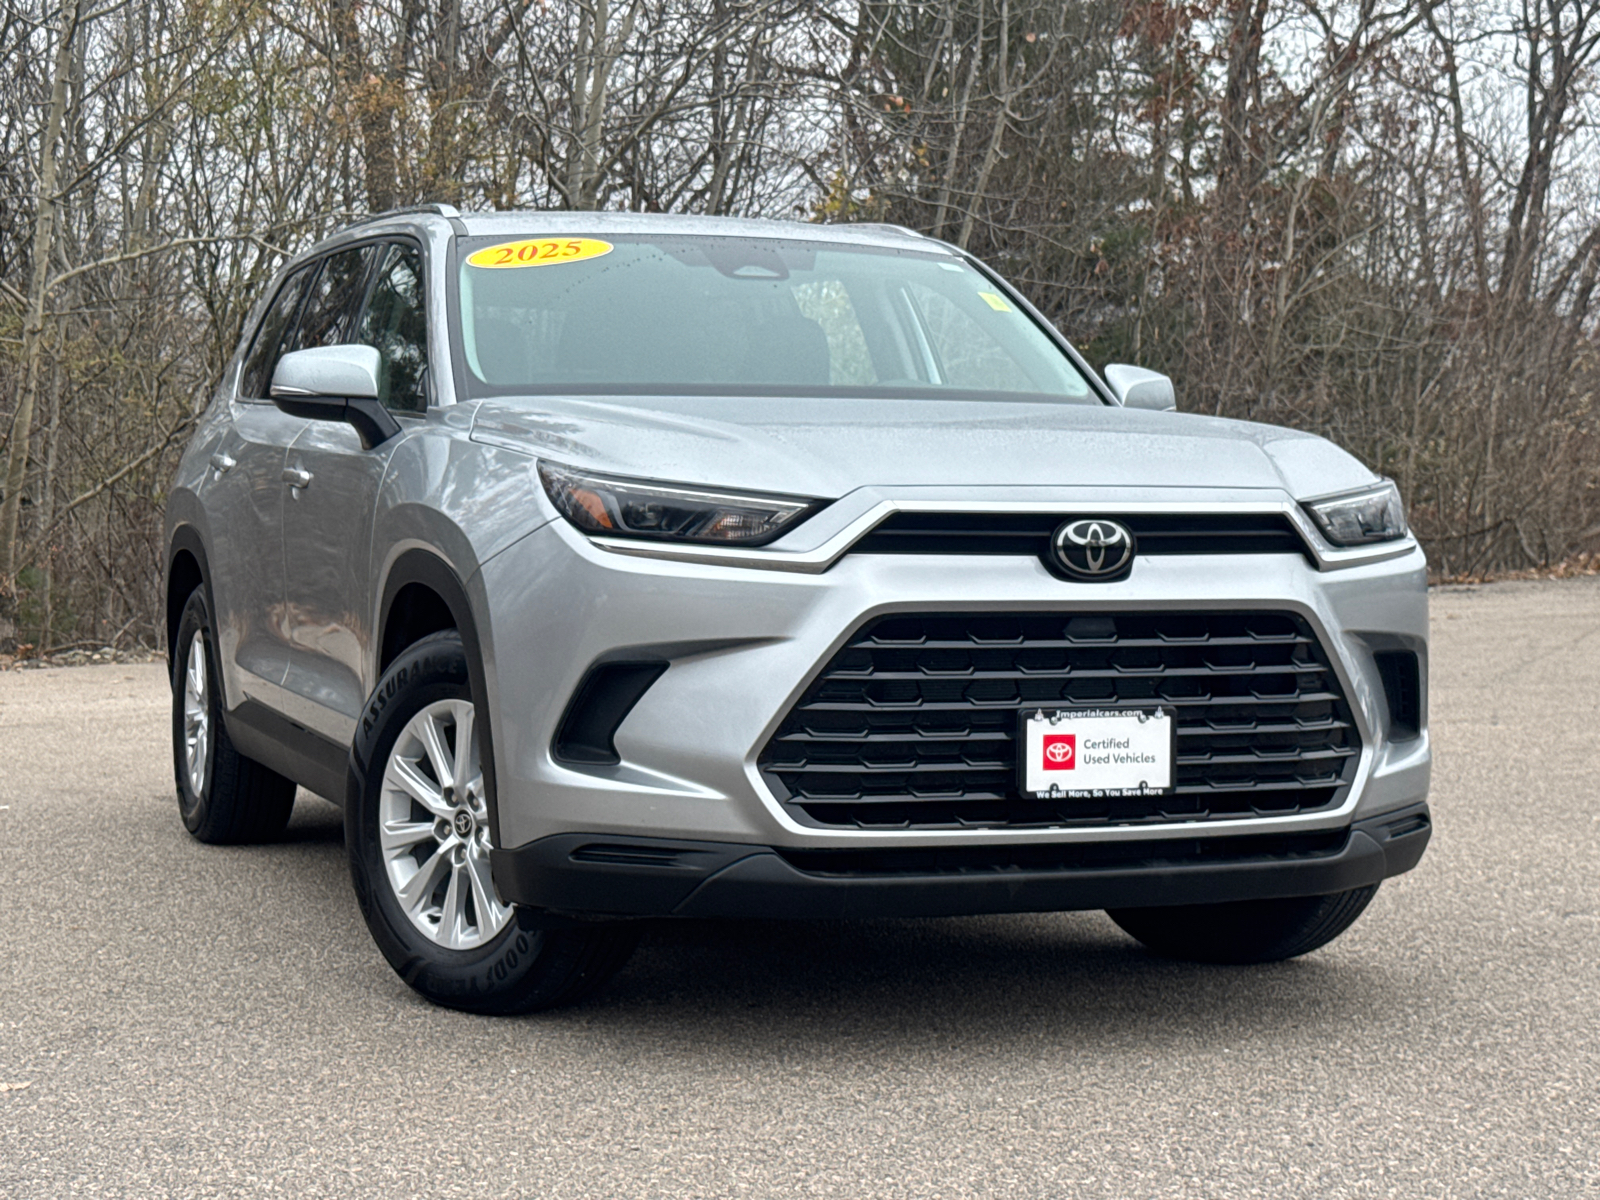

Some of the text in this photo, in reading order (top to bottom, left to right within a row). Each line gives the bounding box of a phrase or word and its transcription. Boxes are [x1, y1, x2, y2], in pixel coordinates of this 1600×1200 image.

[494, 240, 582, 265] 2025
[363, 654, 460, 740] ASSURANCE
[1055, 709, 1143, 719] Imperialcars.com
[1084, 738, 1130, 750] Certified
[1084, 753, 1156, 764] Used Vehicles
[1036, 791, 1050, 799] We
[1051, 790, 1066, 799] Sell
[1092, 789, 1103, 798] So
[1105, 789, 1120, 797] You
[1122, 788, 1141, 797] Save
[1143, 787, 1163, 796] More
[426, 931, 537, 994] OODYEAR
